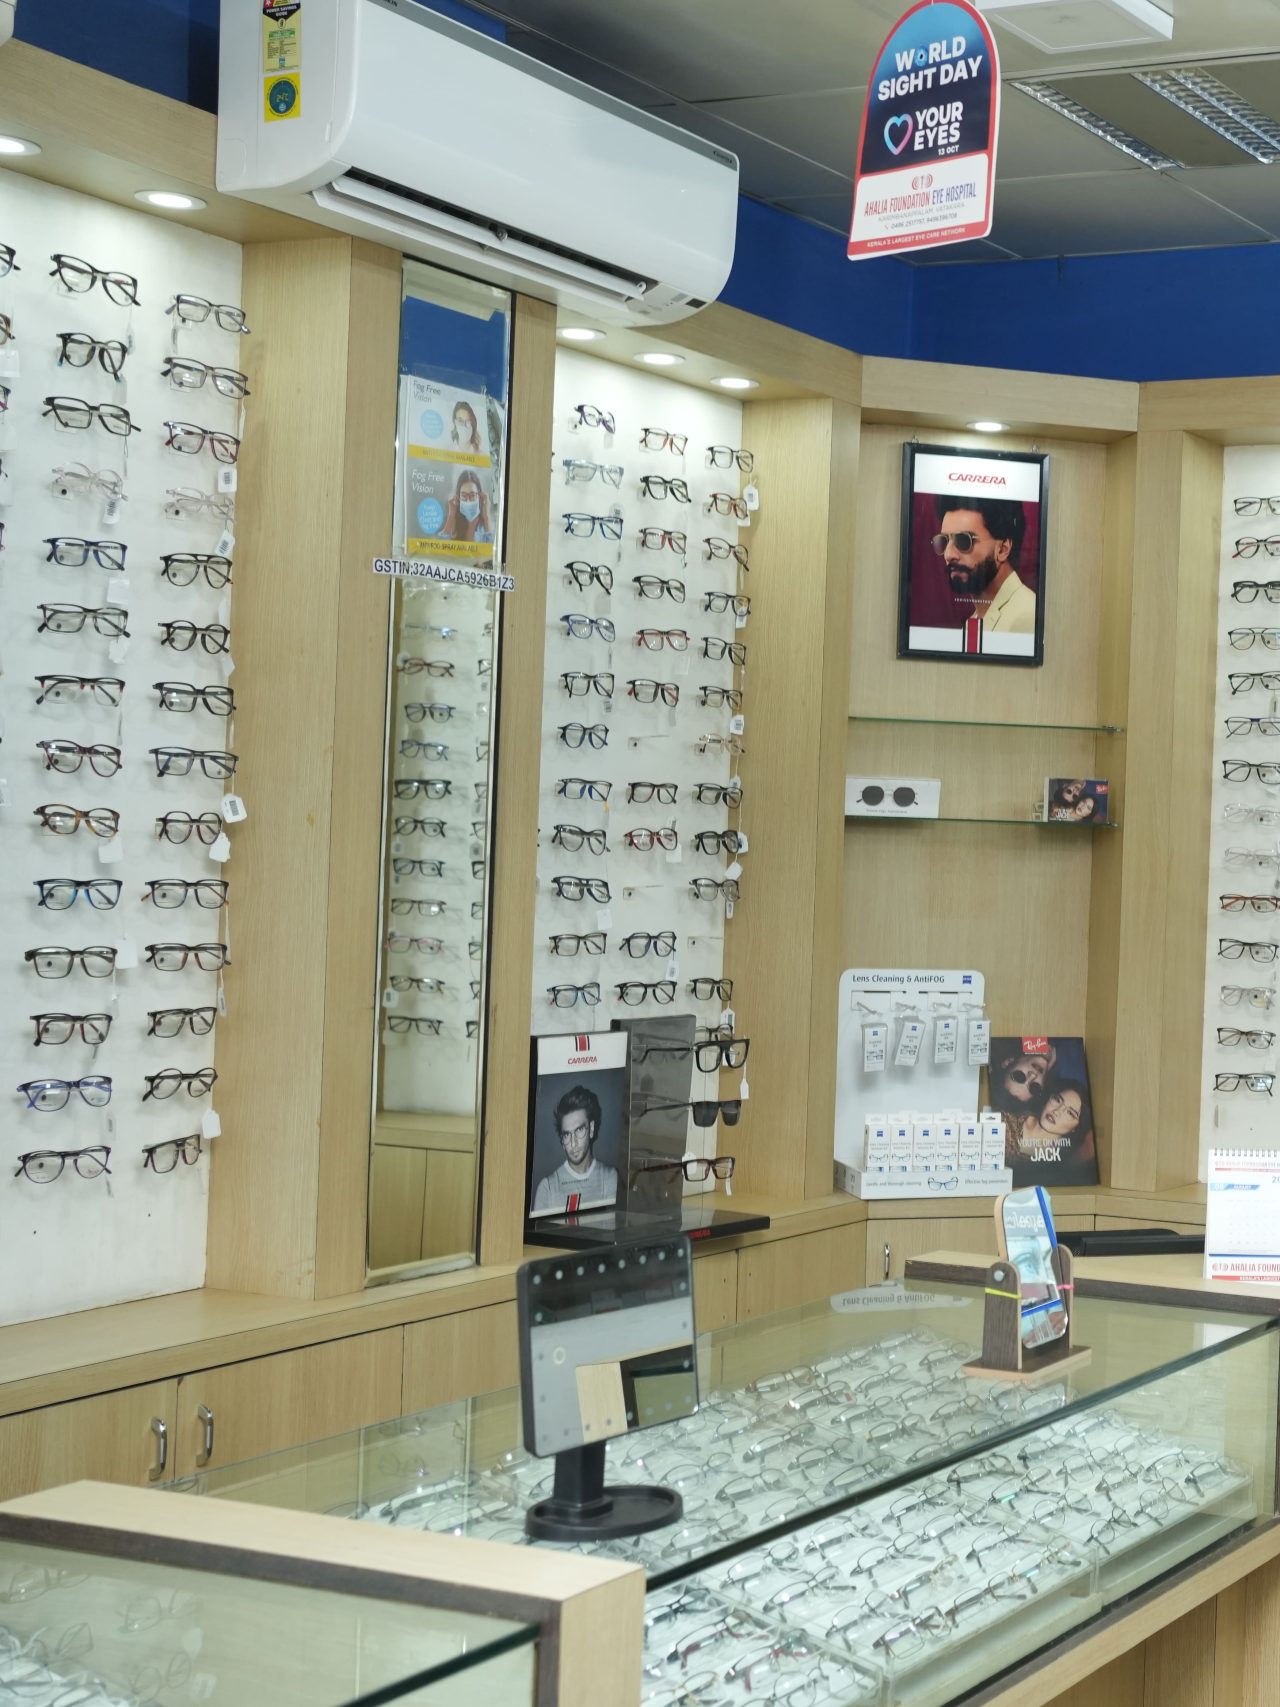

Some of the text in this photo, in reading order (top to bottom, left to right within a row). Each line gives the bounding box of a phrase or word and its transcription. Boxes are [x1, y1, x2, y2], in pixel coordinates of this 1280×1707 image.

[895, 36, 966, 72] WORLD
[877, 55, 983, 101] SIGHT DAY
[915, 101, 964, 130] YOUR
[913, 122, 961, 151] EYES
[937, 145, 960, 156] 13 OCT
[864, 182, 977, 217] AHALIA FOUNDATION EYE HOSPITAL
[891, 235, 915, 245] LARGEST
[915, 234, 925, 242] EYE
[926, 231, 940, 241] CARE
[941, 227, 966, 238] NETWORK
[413, 380, 441, 395] Fog Free
[412, 469, 445, 483] Fog Free
[948, 472, 1007, 486] CARRERA
[412, 482, 434, 494] Vision
[852, 974, 945, 984] Lens Cleaning & AntiFOG
[567, 1056, 598, 1065] CARRERA
[1043, 1138, 1053, 1147] ON
[1053, 1137, 1071, 1147] WITH
[1030, 1147, 1062, 1162] JACK
[1230, 1263, 1256, 1272] AHALIA
